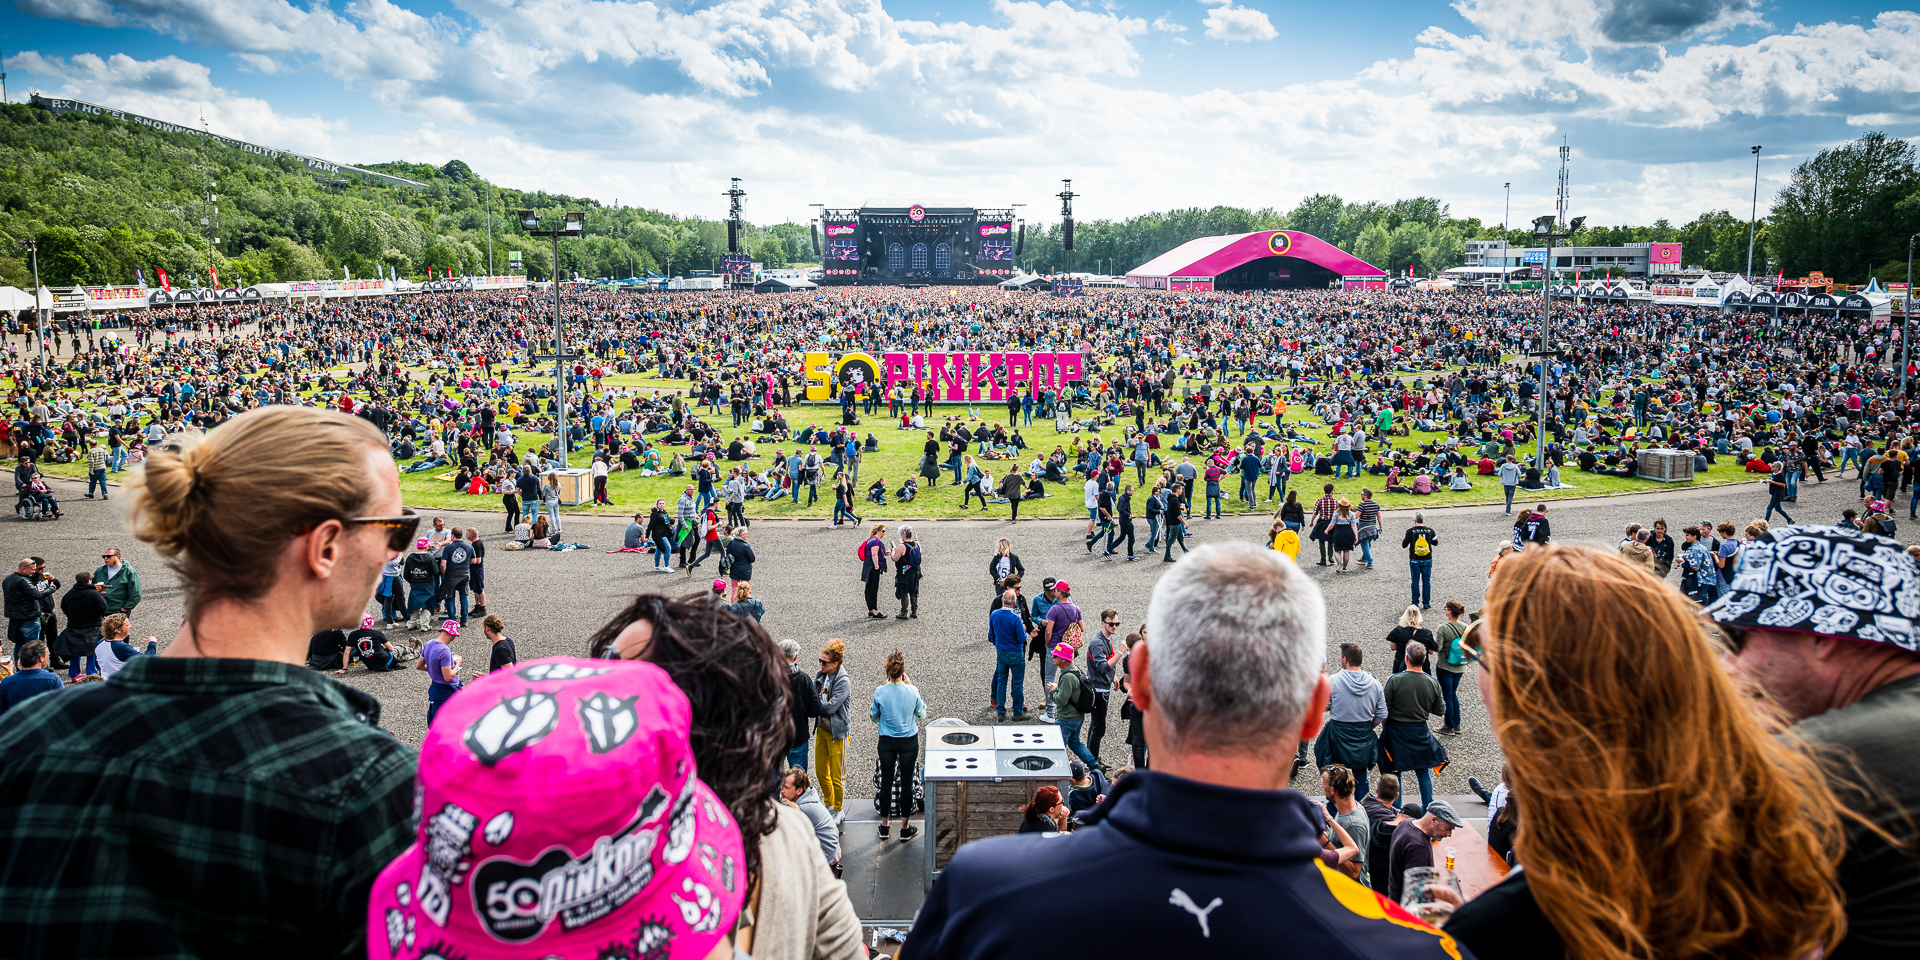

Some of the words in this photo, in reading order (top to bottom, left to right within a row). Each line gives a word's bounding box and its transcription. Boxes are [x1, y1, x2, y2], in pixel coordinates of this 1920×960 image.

[308, 158, 340, 174] PARK
[179, 292, 192, 301] BAR
[1756, 295, 1771, 304] BAR
[1814, 297, 1830, 306] BAR
[805, 352, 882, 402] 50
[884, 352, 1083, 402] PINKPOP
[486, 876, 542, 921] 50
